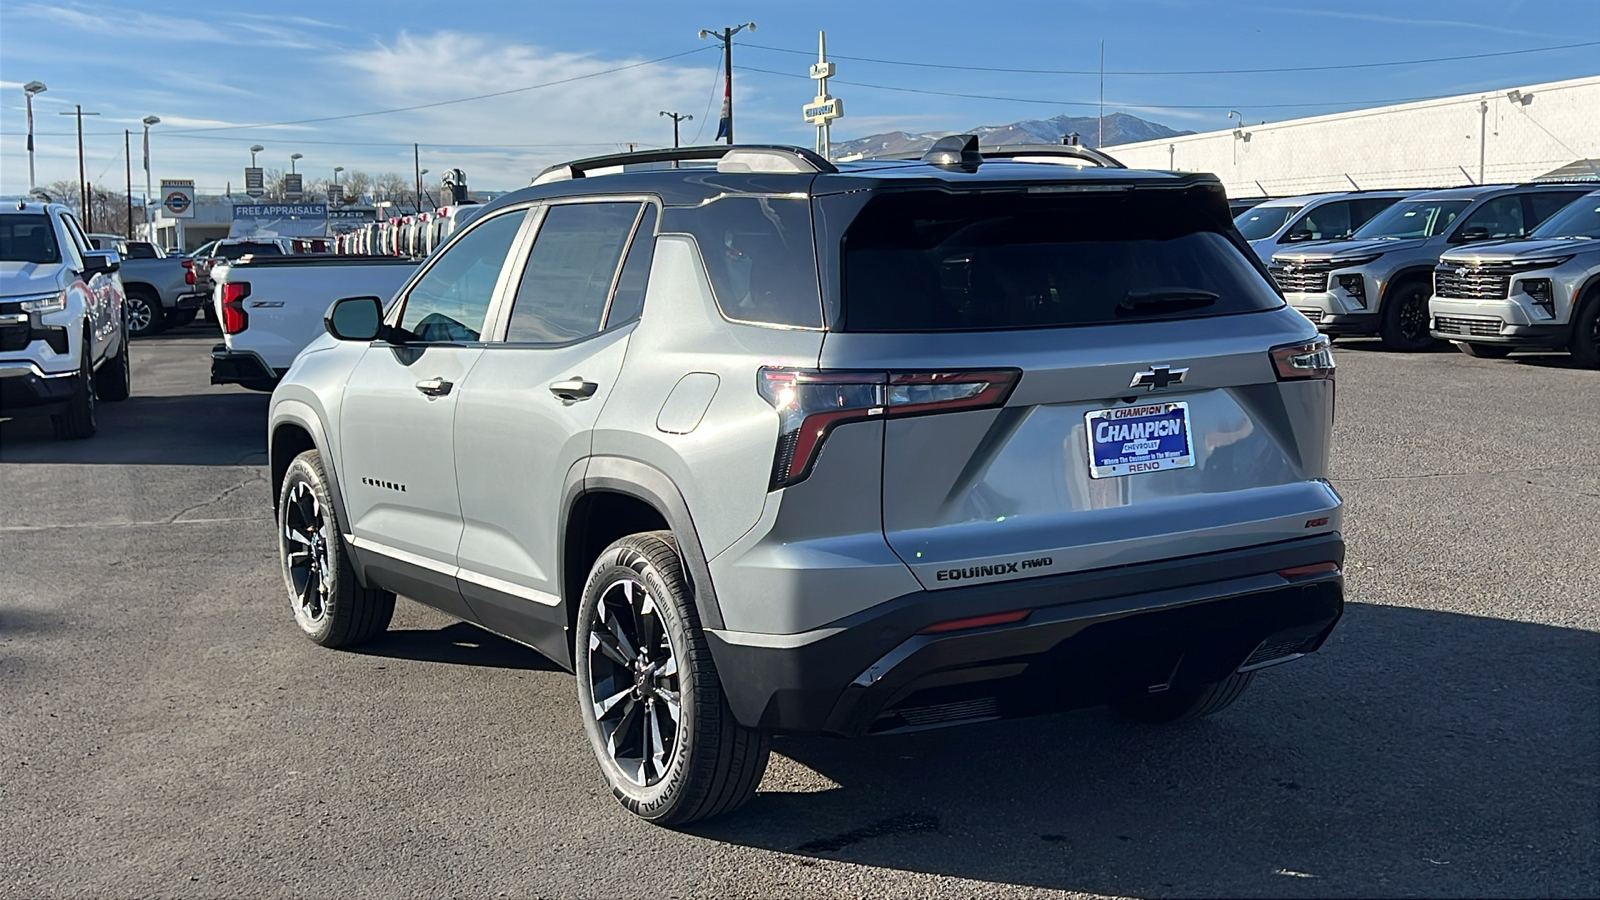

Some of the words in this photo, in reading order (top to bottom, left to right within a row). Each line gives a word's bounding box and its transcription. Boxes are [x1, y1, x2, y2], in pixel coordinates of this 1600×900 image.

[236, 206, 261, 216] FREE
[263, 206, 324, 216] APPRAISALS!
[1115, 406, 1161, 418] CHAMPION
[1096, 419, 1181, 443] CHAMPION
[1124, 442, 1157, 451] CHEVROLET
[1129, 462, 1160, 473] RENO
[362, 477, 407, 493] EQUINOX
[1305, 517, 1329, 529] RS
[937, 560, 1019, 582] EQUINOX
[1021, 556, 1053, 570] AWD
[641, 711, 690, 813] CONTINENTAL
